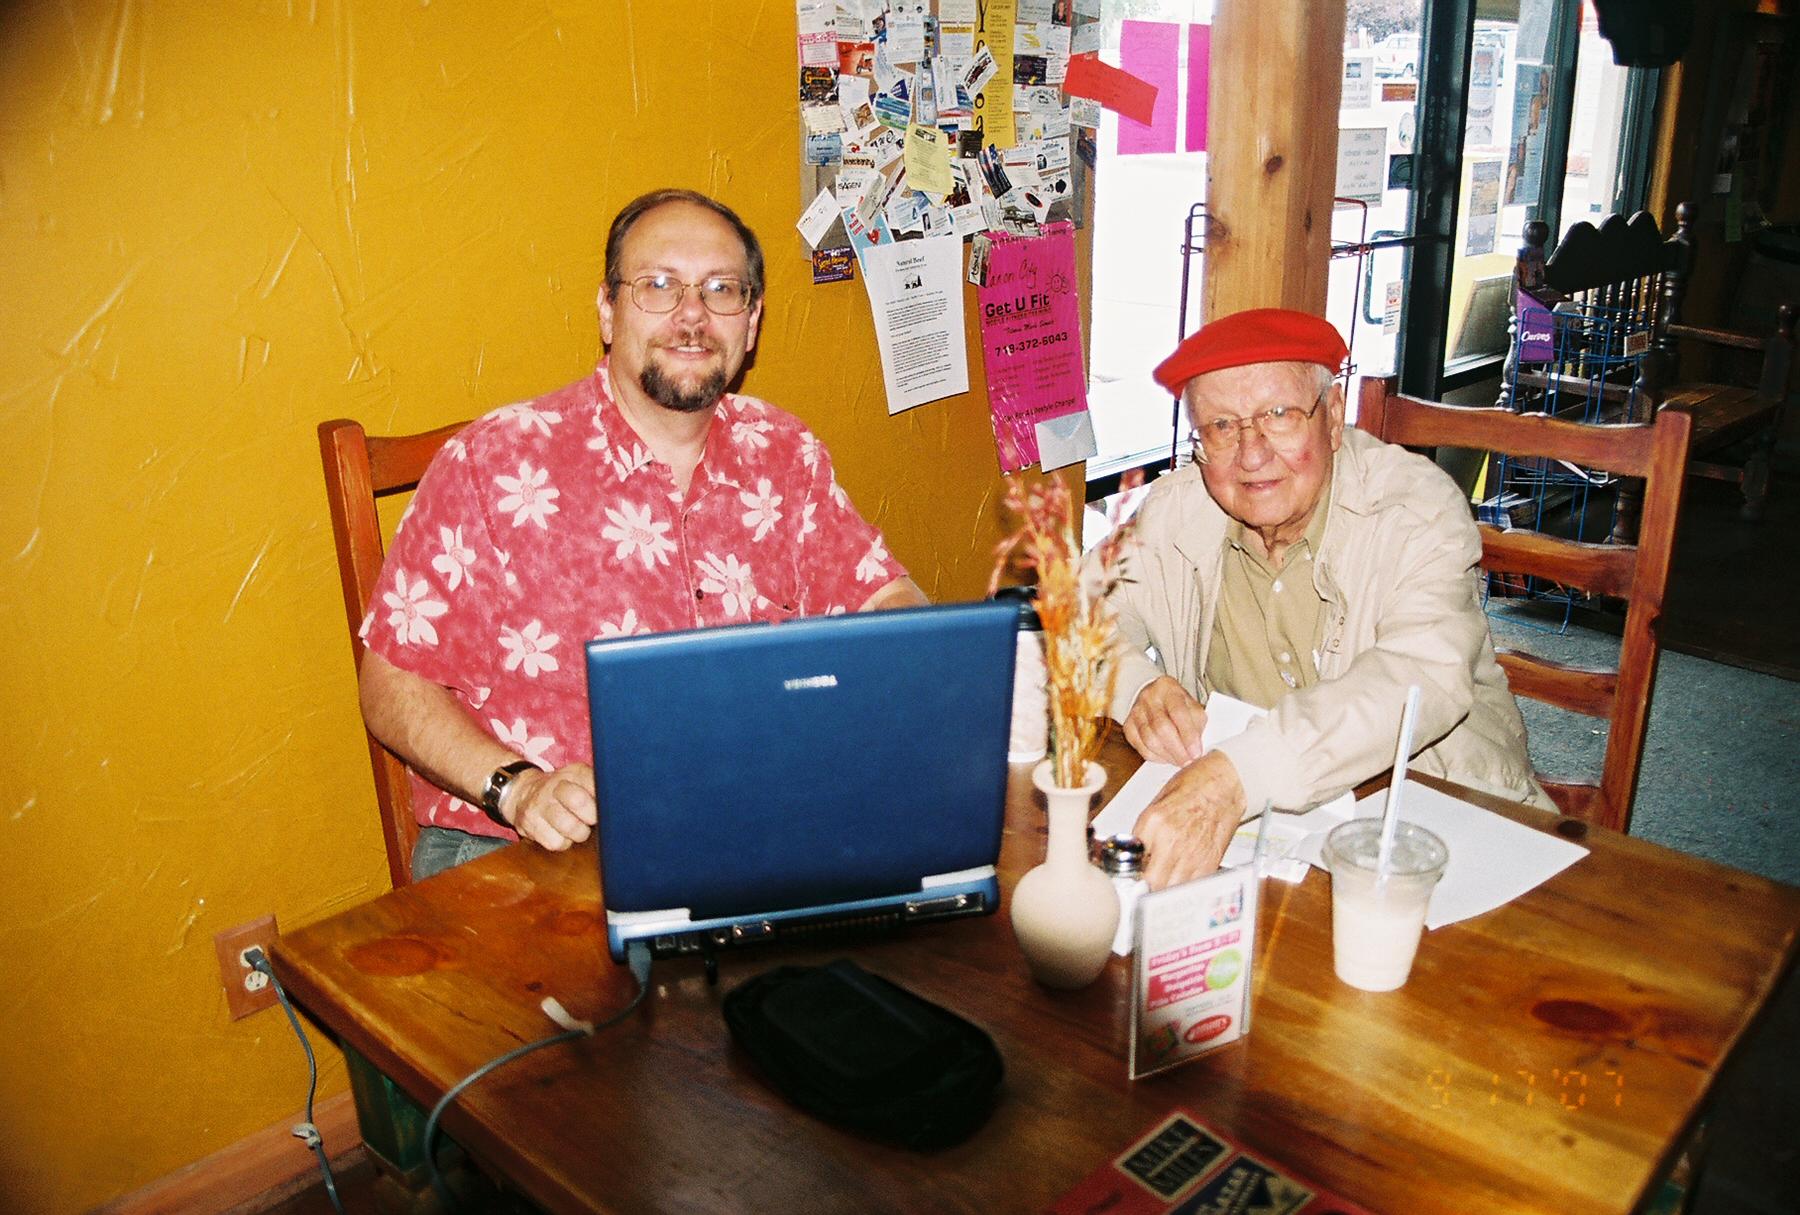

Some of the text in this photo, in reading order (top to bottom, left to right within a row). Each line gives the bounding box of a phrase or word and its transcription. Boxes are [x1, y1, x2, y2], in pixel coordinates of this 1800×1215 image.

[985, 303, 1012, 317] Get
[1015, 296, 1025, 311] U
[1031, 293, 1049, 308] Fit
[1521, 330, 1551, 342] Curves
